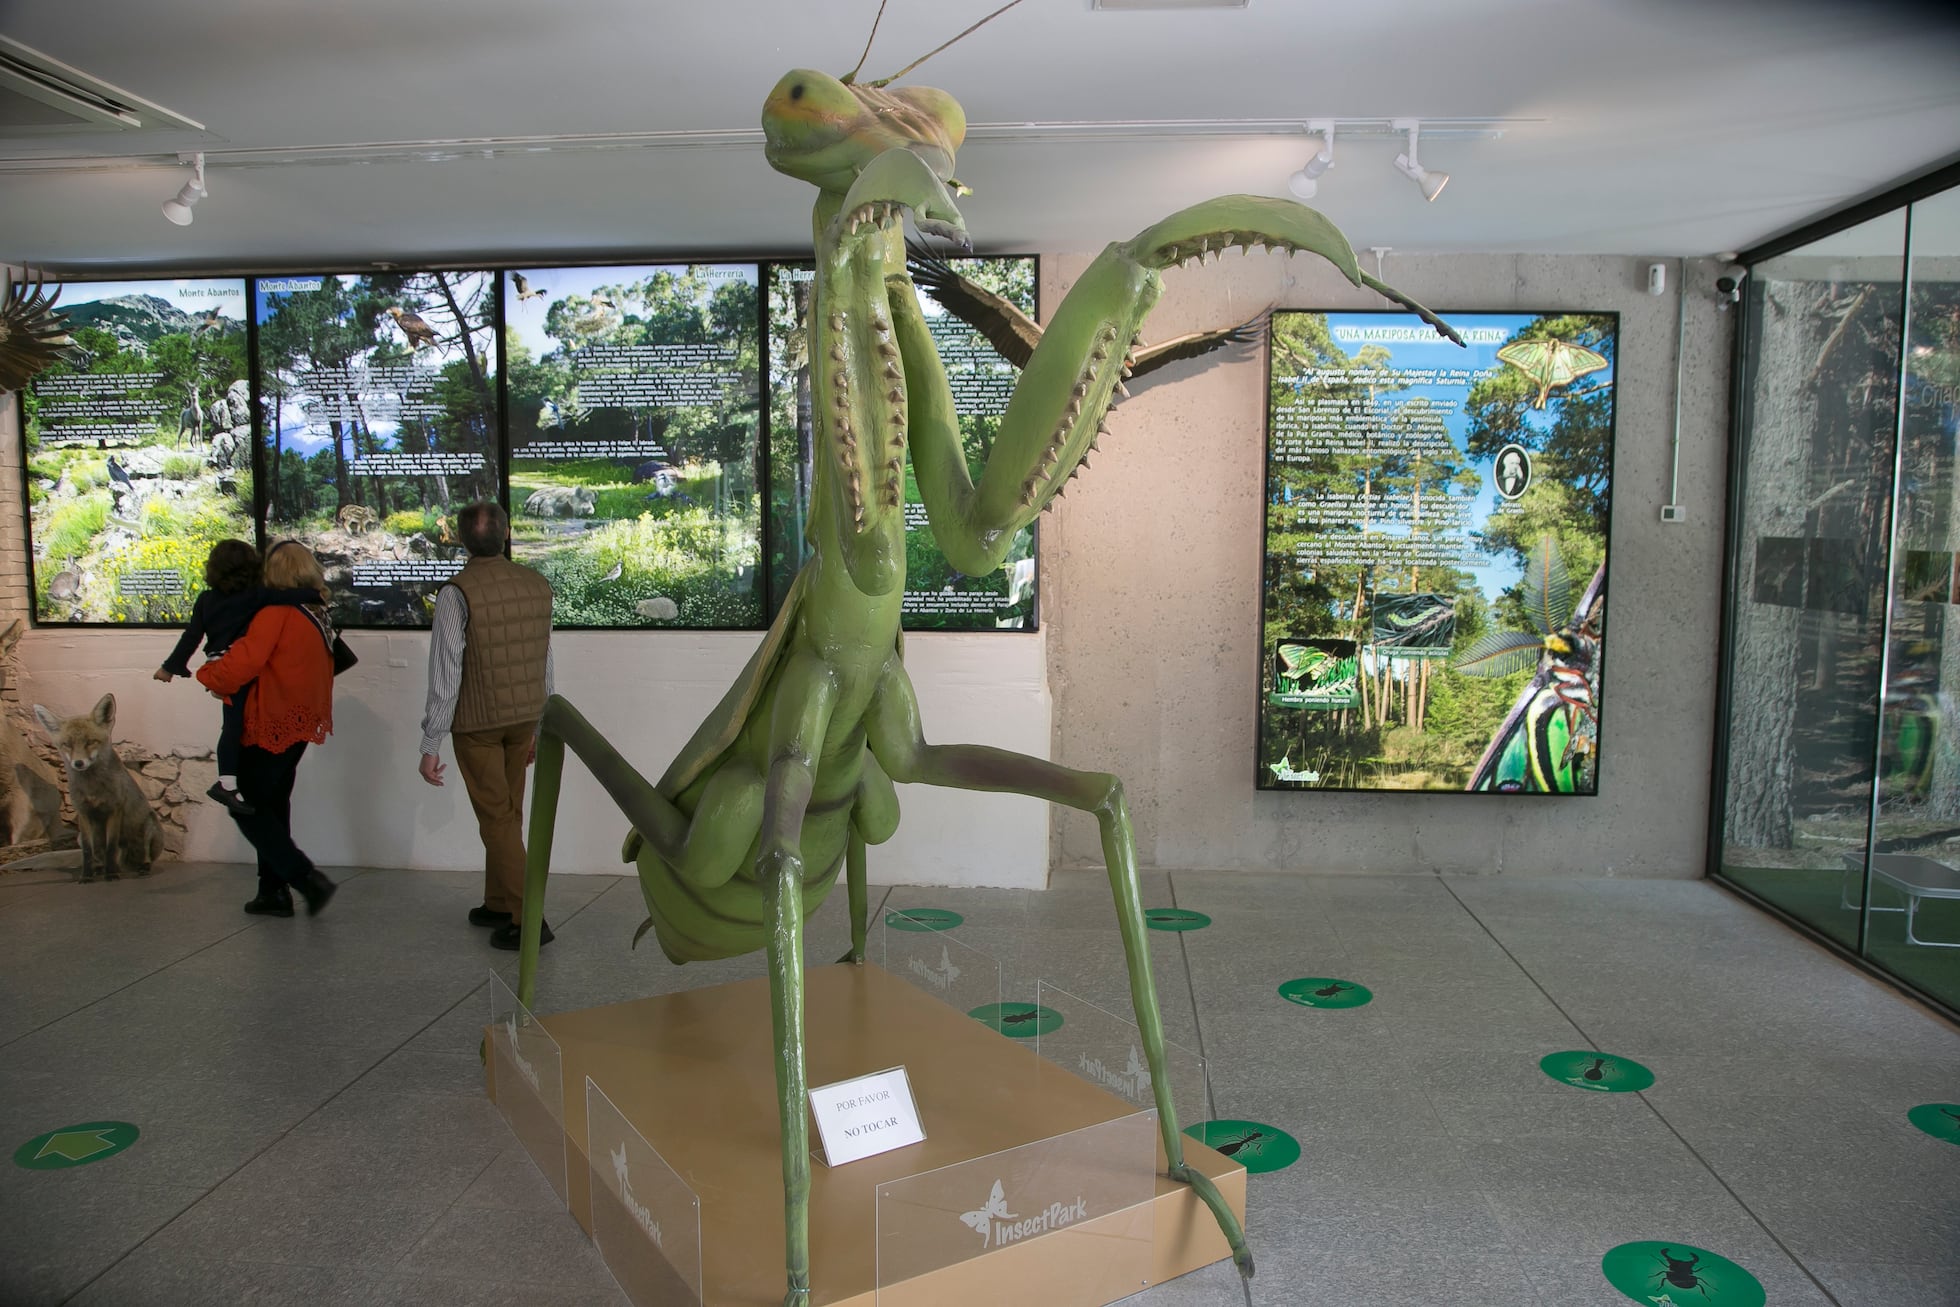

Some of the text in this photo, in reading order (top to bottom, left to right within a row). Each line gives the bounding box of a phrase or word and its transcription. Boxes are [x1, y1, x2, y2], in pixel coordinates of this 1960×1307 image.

[695, 268, 706, 278] La
[780, 269, 816, 280] La Herr
[260, 280, 321, 291] Monte Abantos
[179, 287, 240, 298] Monte Abantos
[1364, 328, 1415, 340] MARIPOSA
[1419, 329, 1442, 340] PAR
[1316, 369, 1345, 377] augusto
[1348, 368, 1376, 376] nombre
[1380, 368, 1388, 376] de
[1404, 369, 1437, 378] Majestad
[1318, 398, 1348, 407] plasmaba
[1297, 415, 1326, 423] mariposa
[1412, 440, 1448, 448] descripción
[1332, 447, 1359, 455] hallazgo
[1321, 517, 1345, 525] pinares
[836, 1090, 890, 1112] POR FAVOR
[844, 1116, 898, 1138] NO TOCAR
[624, 1180, 662, 1248] InsectPark
[996, 1196, 1088, 1246] InsectPark
